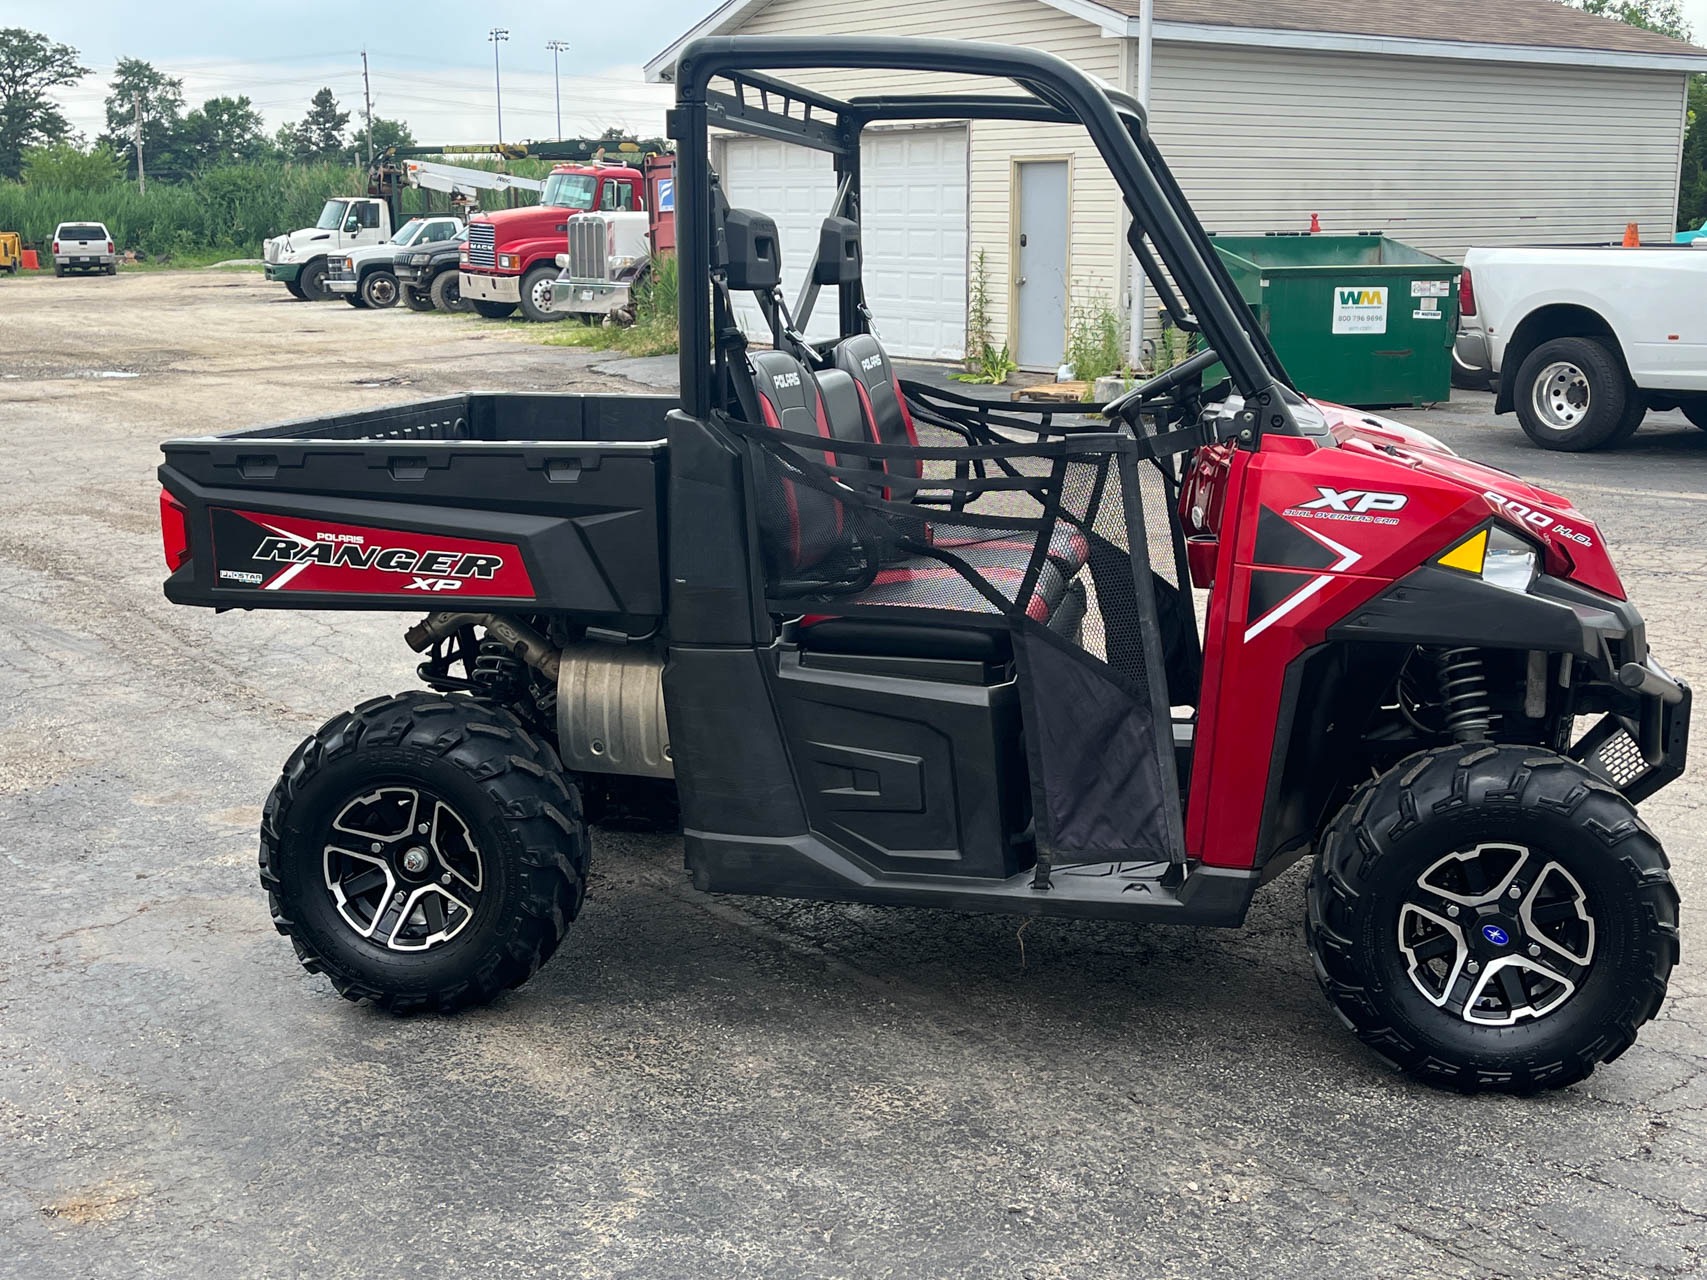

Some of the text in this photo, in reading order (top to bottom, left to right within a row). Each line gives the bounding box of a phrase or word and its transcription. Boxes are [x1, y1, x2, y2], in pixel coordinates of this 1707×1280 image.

[470, 243, 494, 251] MACK
[1339, 291, 1382, 305] WM
[861, 353, 882, 373] POLARIS
[773, 373, 800, 389] POLARIS
[1295, 486, 1409, 513] XP
[1283, 508, 1400, 526] DUAL OVERHEAD CAM
[316, 532, 365, 545] POLARIS
[252, 536, 503, 579] RANGER
[403, 576, 462, 592] XP
